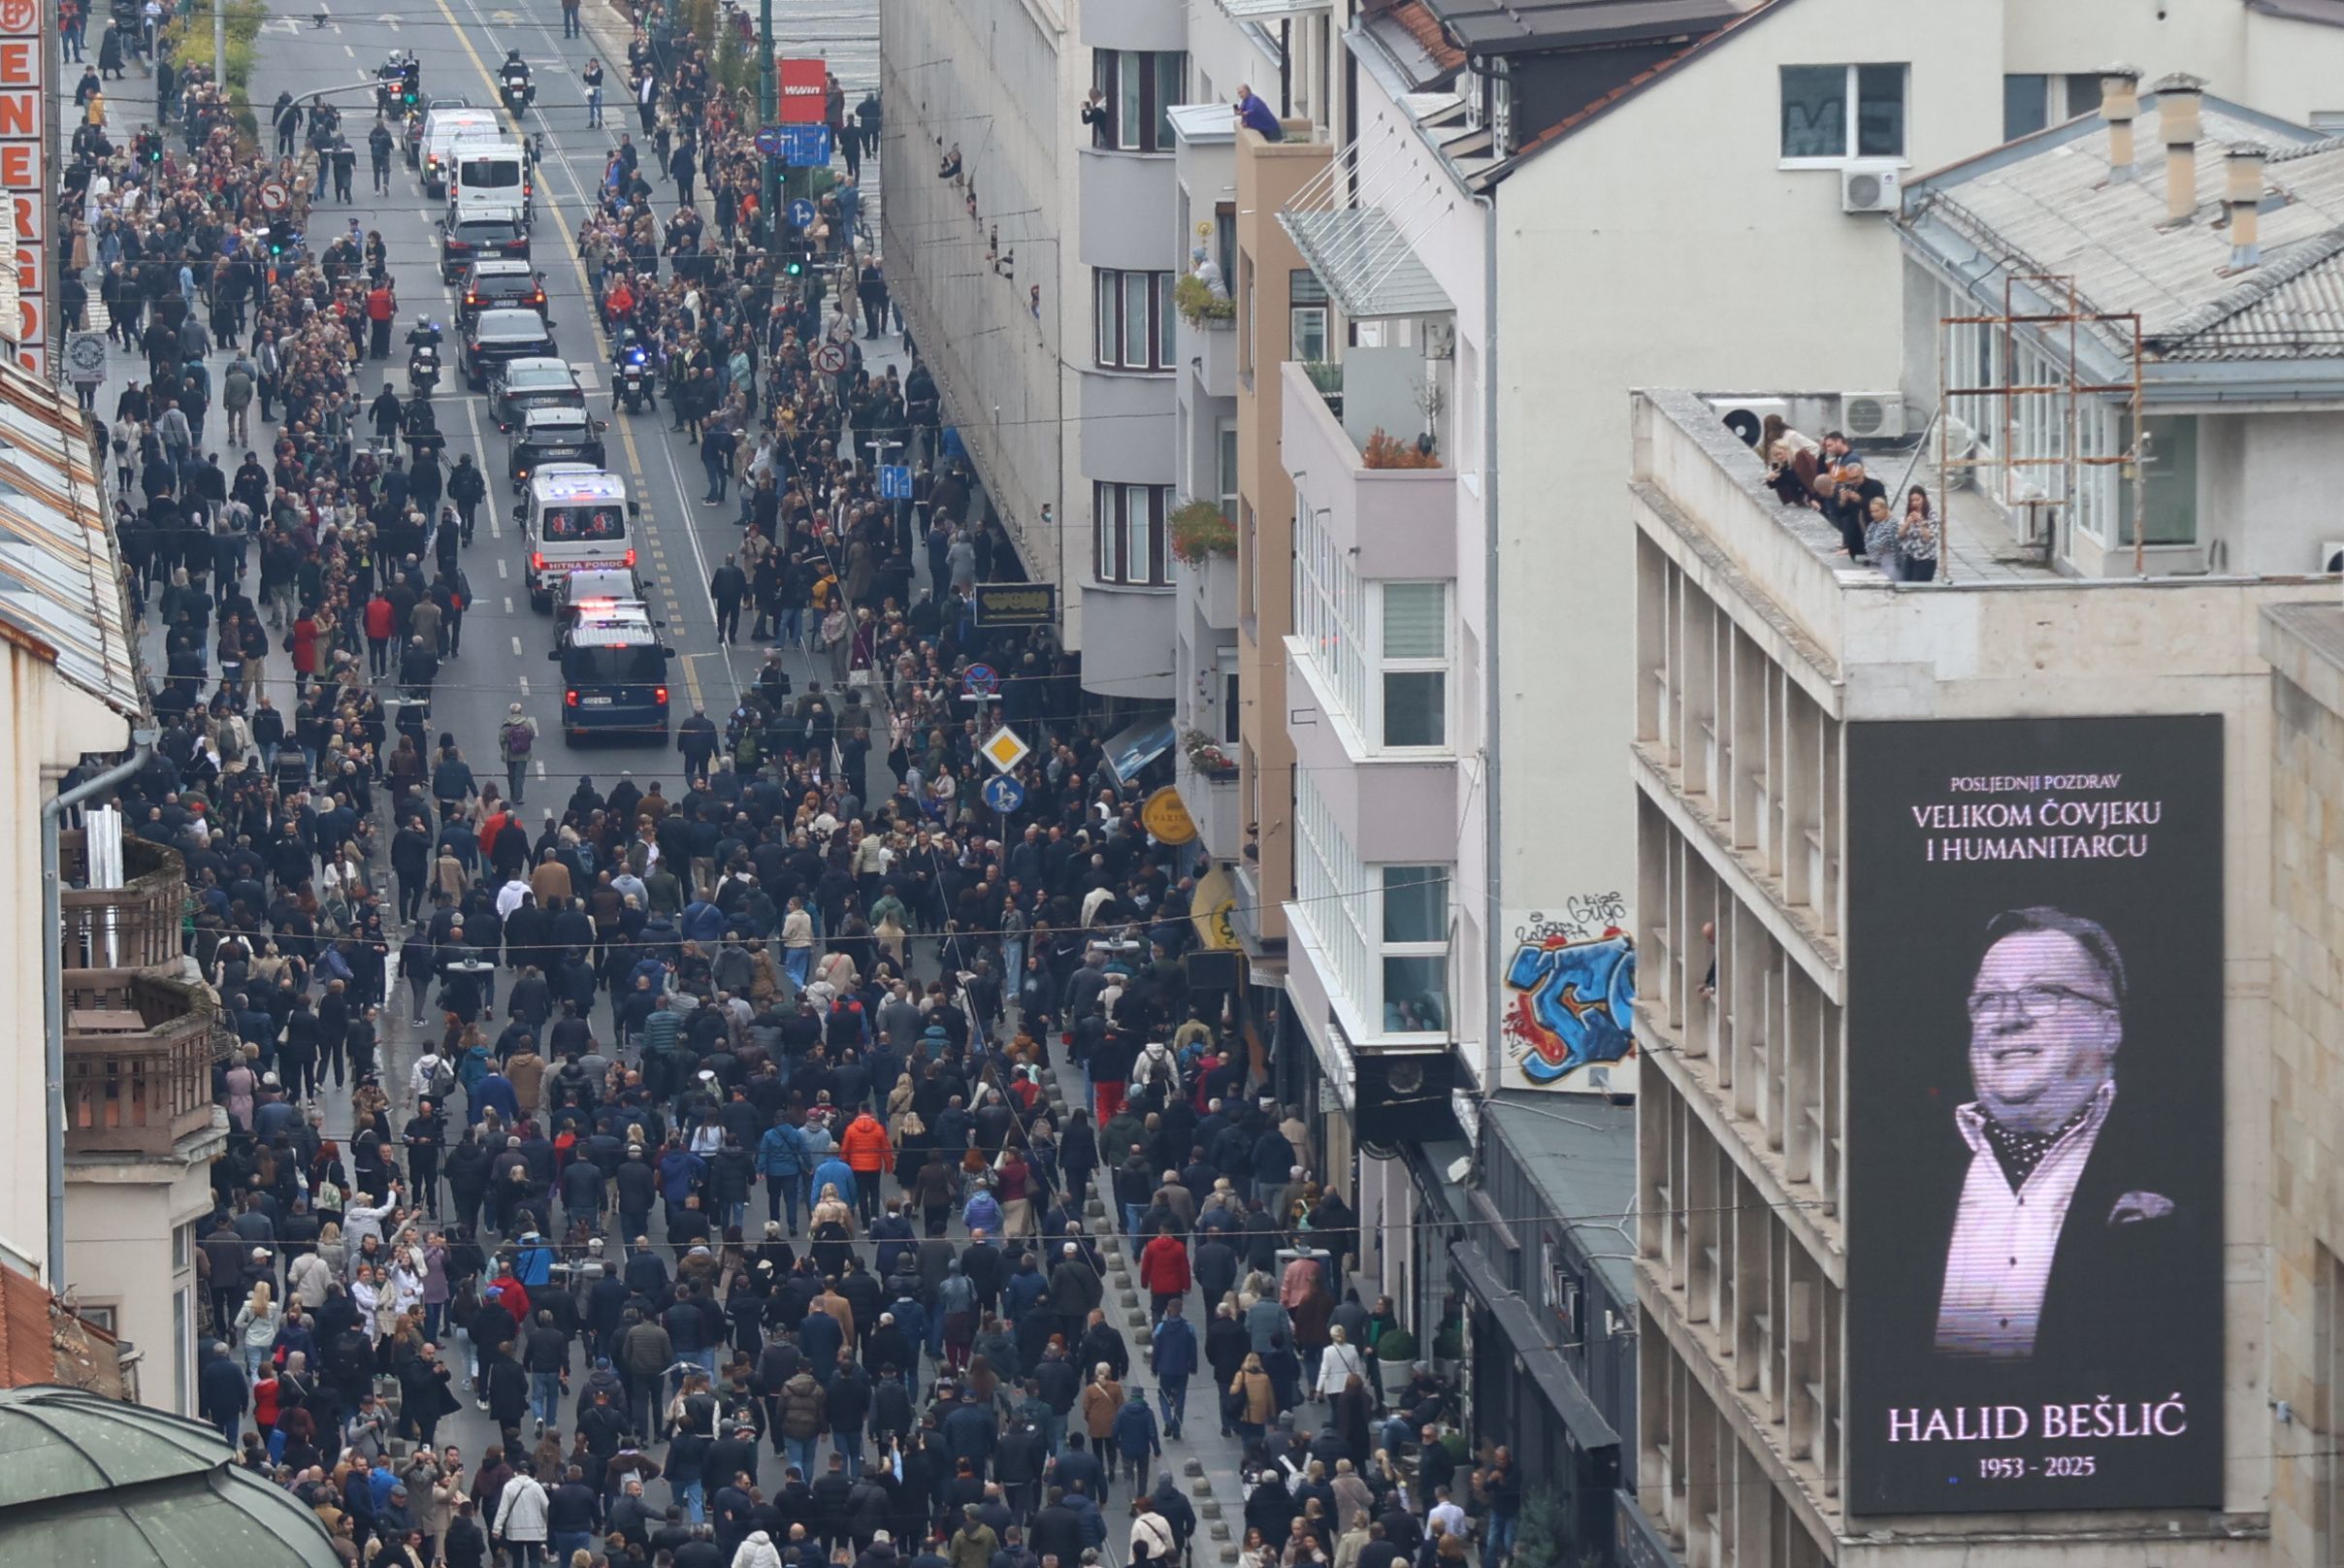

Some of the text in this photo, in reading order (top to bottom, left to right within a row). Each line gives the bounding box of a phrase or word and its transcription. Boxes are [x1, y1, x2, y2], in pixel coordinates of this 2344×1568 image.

[1951, 773, 2122, 793] POSLJEDNJI POZDRAV
[1911, 799, 2162, 830] VELIKOM ČOVJEKU
[1926, 833, 2148, 861] I HUMANITARCU
[1888, 1392, 2188, 1442] HALID BEŠLIĆ
[1979, 1458, 2025, 1479] 1953
[2043, 1456, 2097, 1477] 2025
